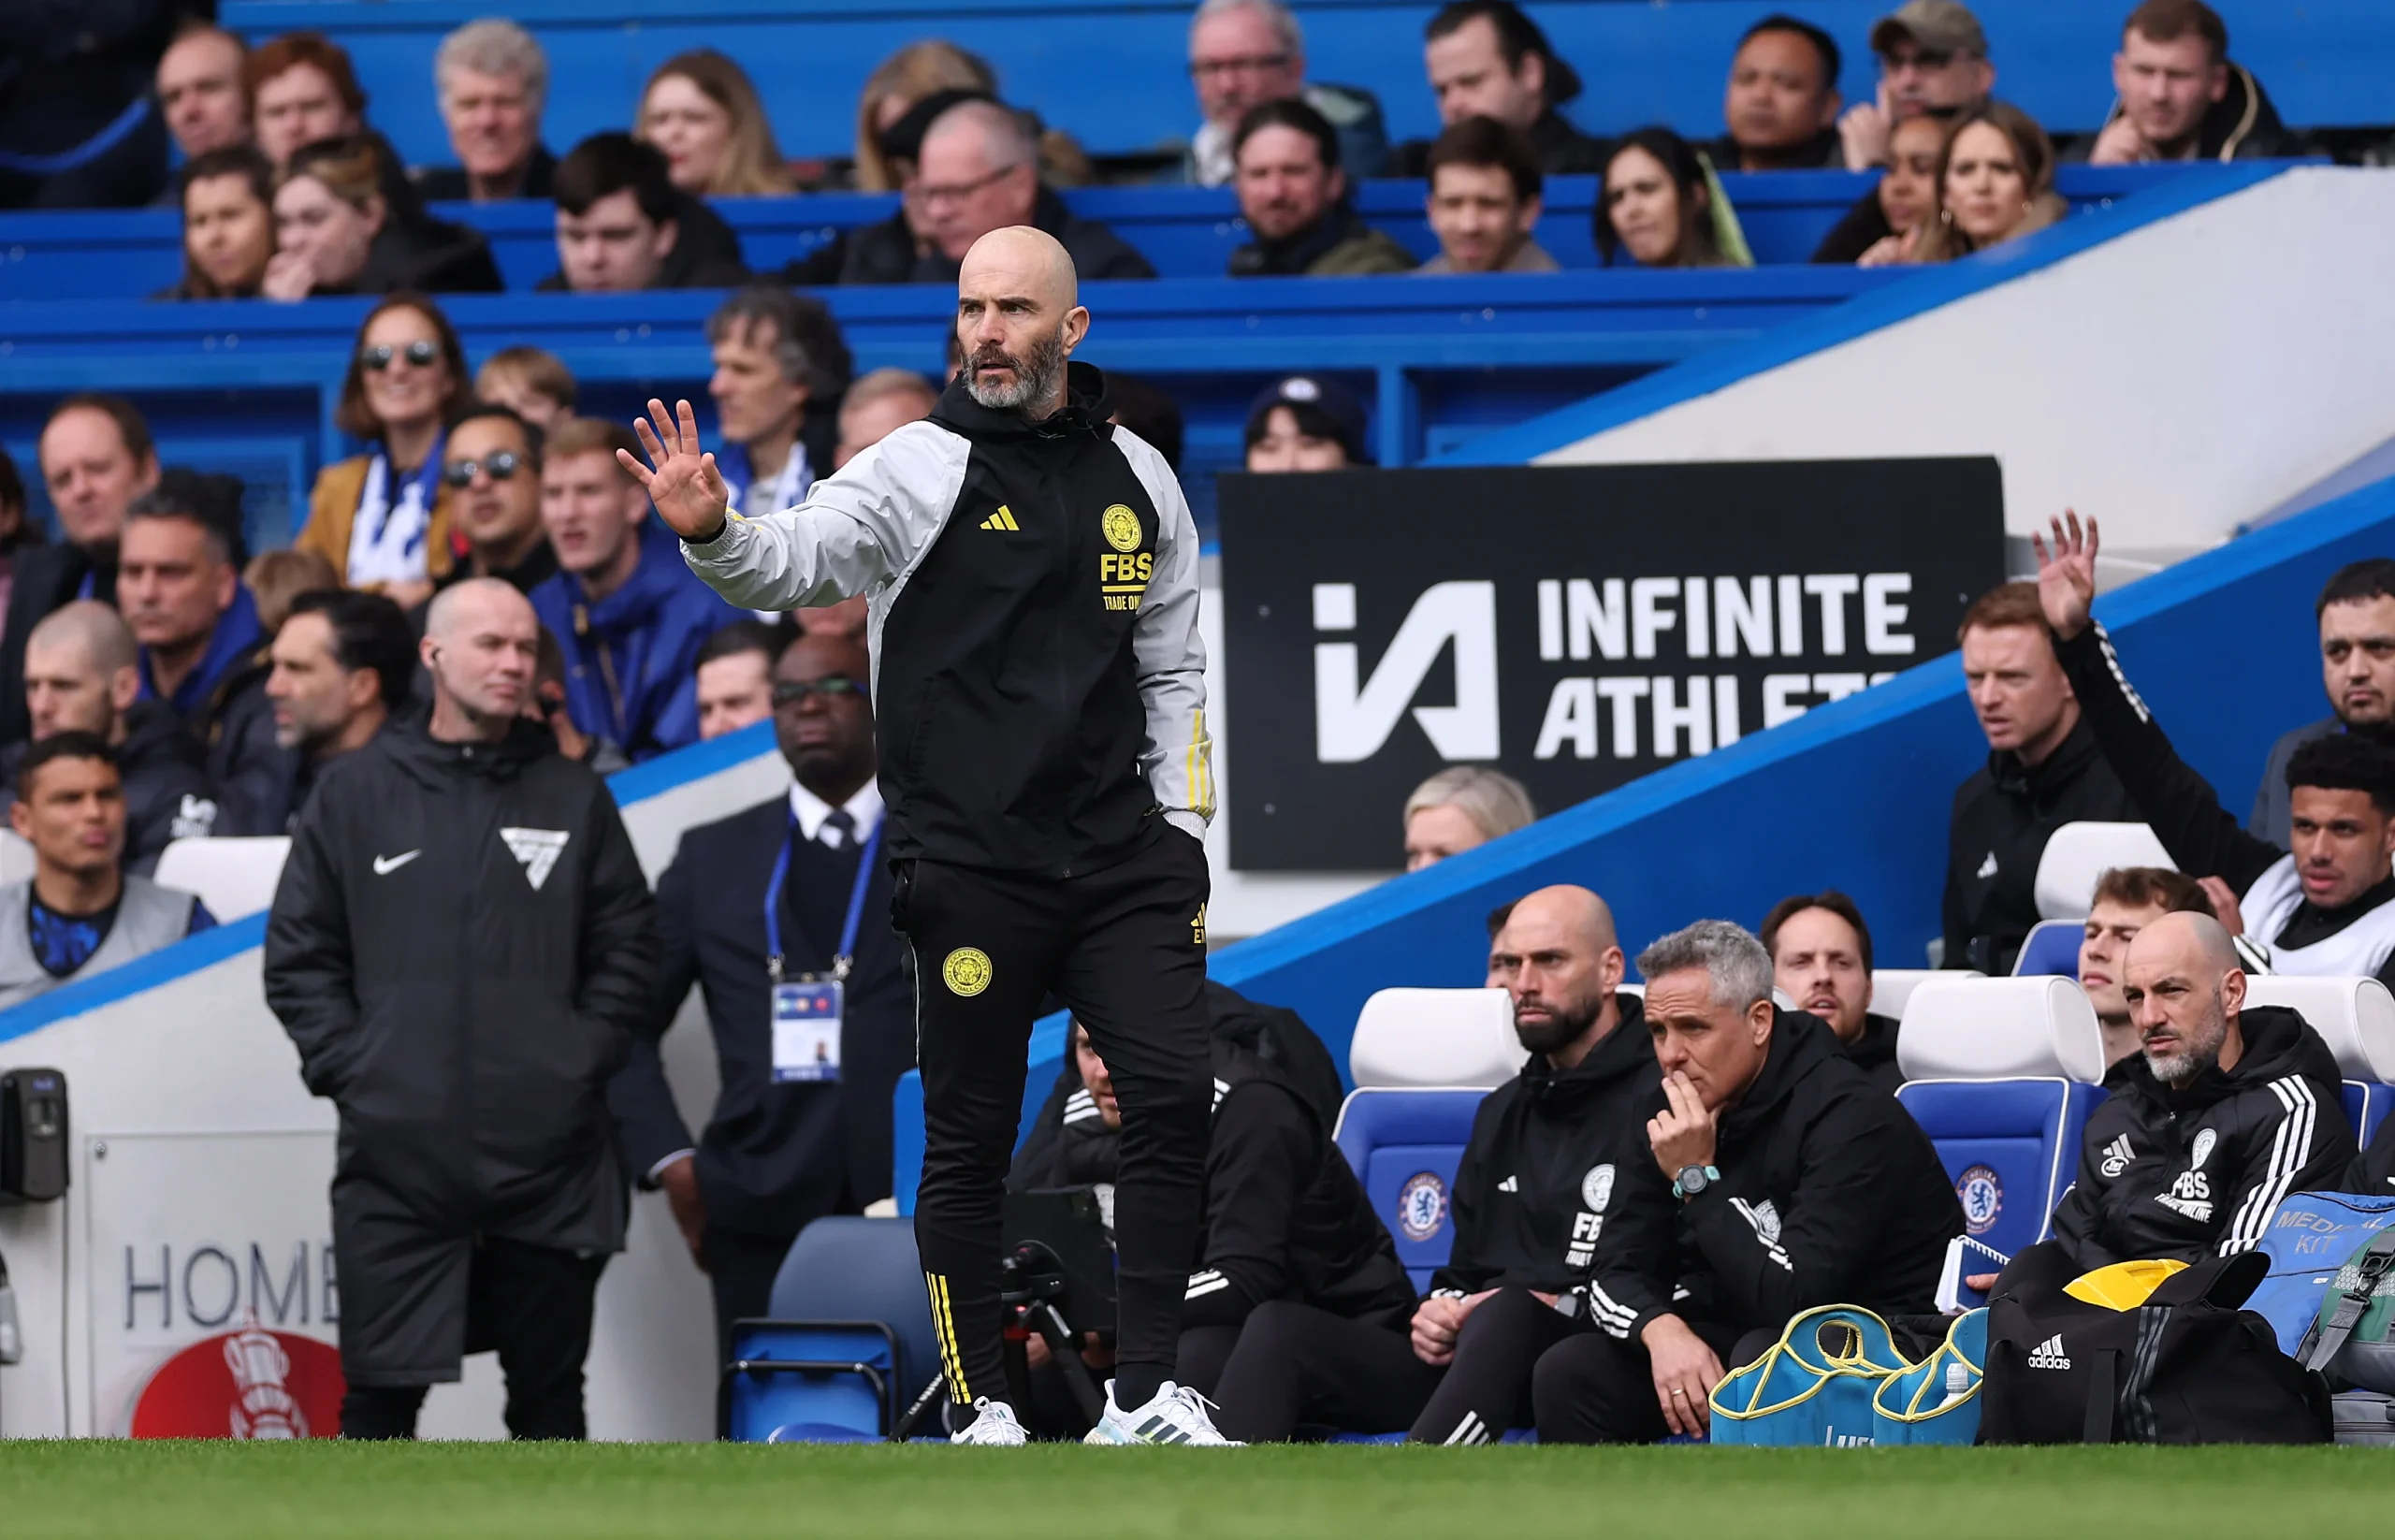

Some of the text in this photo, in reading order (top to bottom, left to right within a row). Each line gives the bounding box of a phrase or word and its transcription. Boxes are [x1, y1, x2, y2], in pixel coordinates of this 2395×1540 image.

[1100, 552, 1153, 582] FBS
[1103, 595, 1127, 611] TRADE
[1538, 573, 1916, 661] INFINITE
[2294, 1234, 2339, 1255] KIT
[2027, 1354, 2071, 1370] adidas
